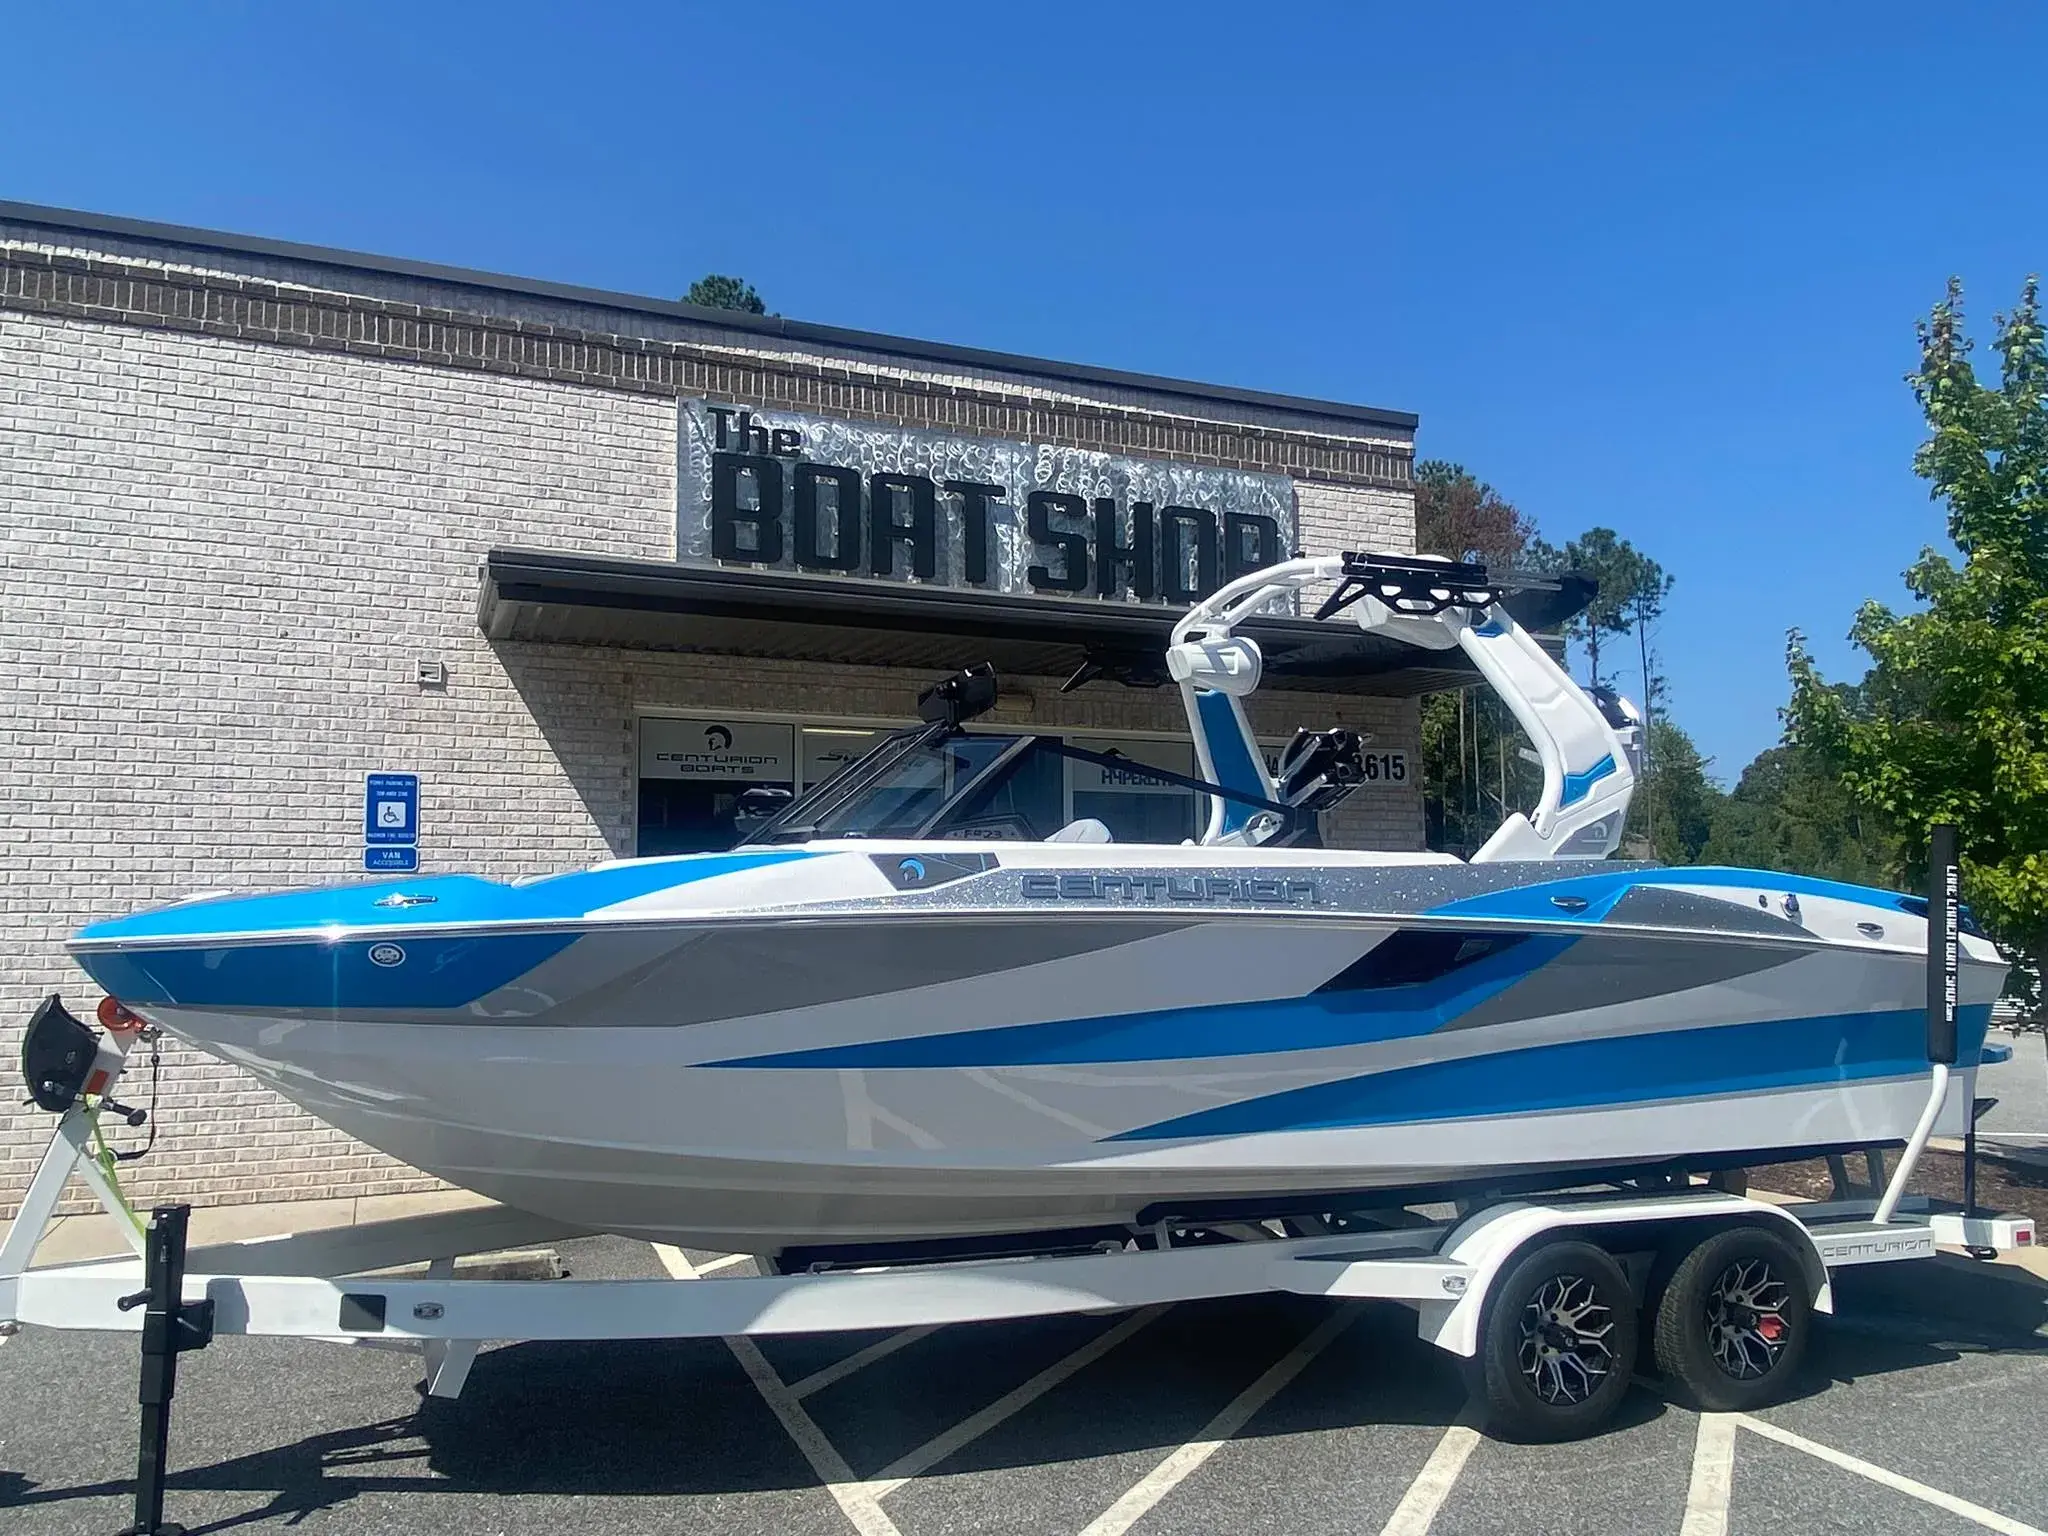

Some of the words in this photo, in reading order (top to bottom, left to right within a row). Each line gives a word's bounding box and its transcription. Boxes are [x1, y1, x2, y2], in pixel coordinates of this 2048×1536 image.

[707, 407, 801, 457] The
[711, 452, 1007, 583] BOAT
[1027, 490, 1279, 604] SHOP
[656, 752, 778, 765] CENTURION
[680, 763, 755, 775] BOATS
[382, 851, 401, 859] VAN
[1021, 873, 1321, 904] CENTURION
[1822, 1238, 1932, 1258] CENTURION
